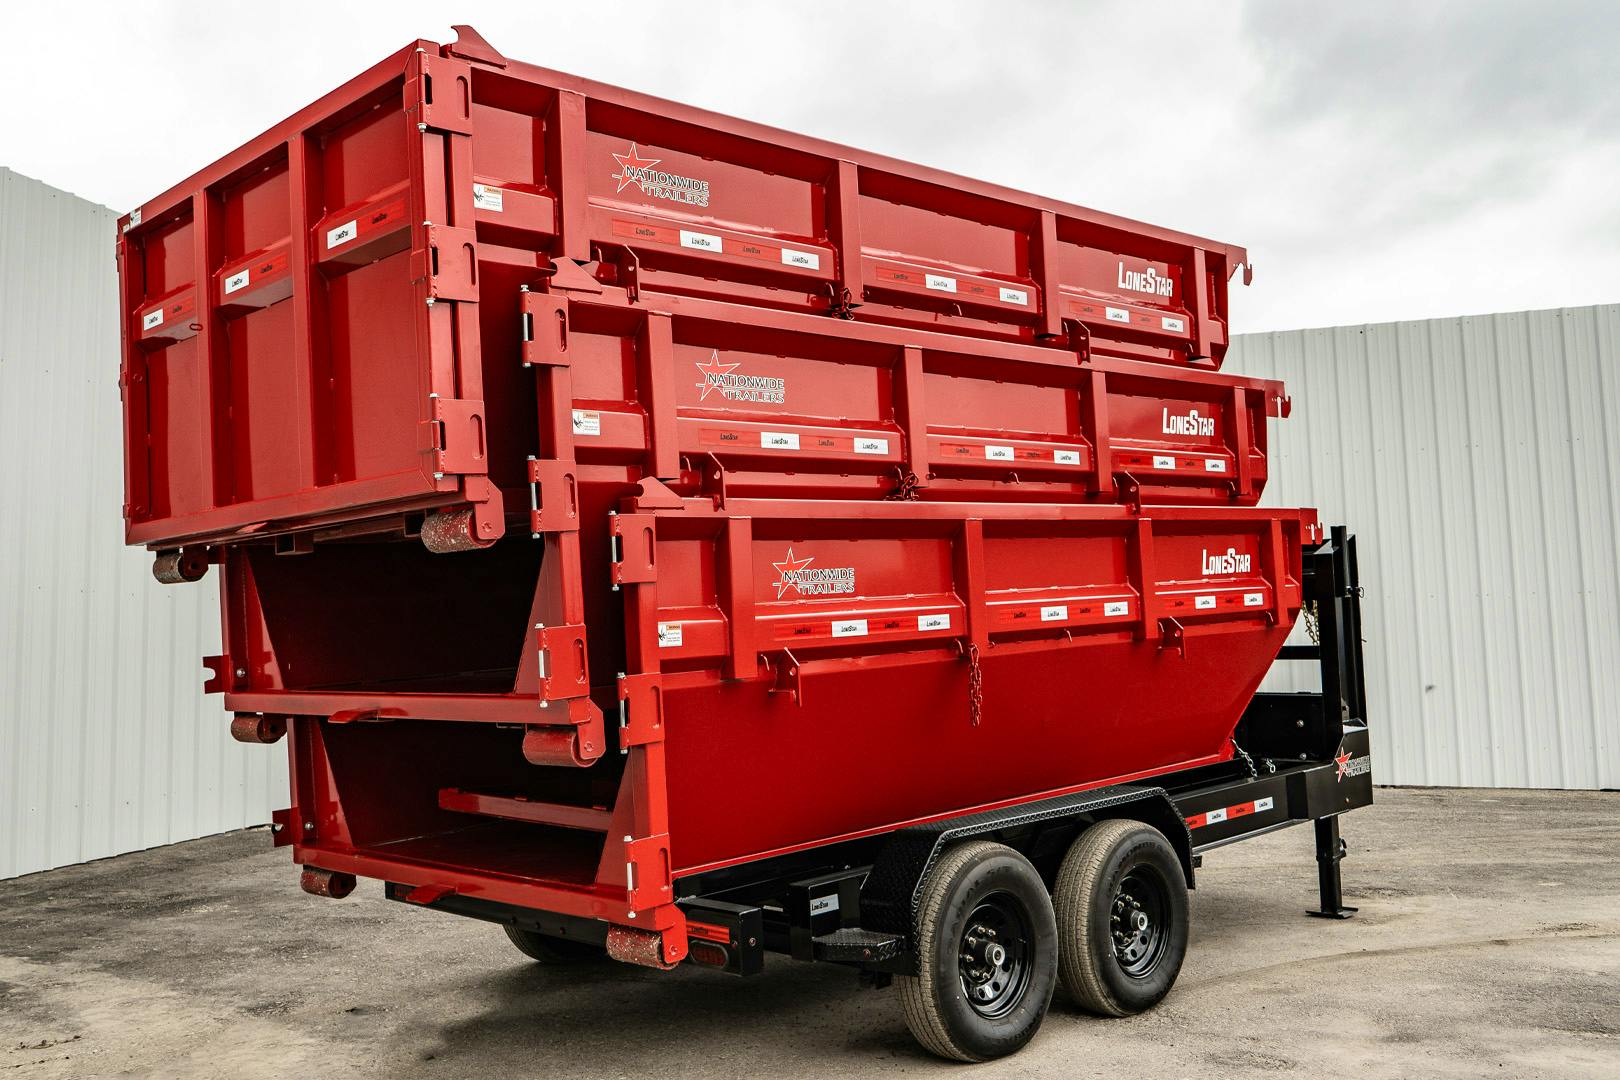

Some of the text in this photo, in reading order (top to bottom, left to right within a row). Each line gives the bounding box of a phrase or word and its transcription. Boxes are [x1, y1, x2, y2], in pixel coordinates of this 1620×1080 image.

[625, 165, 708, 191] NATIONWIDE
[645, 186, 708, 207] TRAILERS
[1118, 261, 1173, 297] LONESTAR
[707, 371, 784, 389] NATIONWIDE
[726, 389, 784, 404] TRAILERS
[1162, 407, 1214, 436] LONESTAR
[1202, 547, 1251, 575] LONESTAR
[783, 567, 854, 582] NATIONWIDE
[801, 582, 855, 595] TRAILERS
